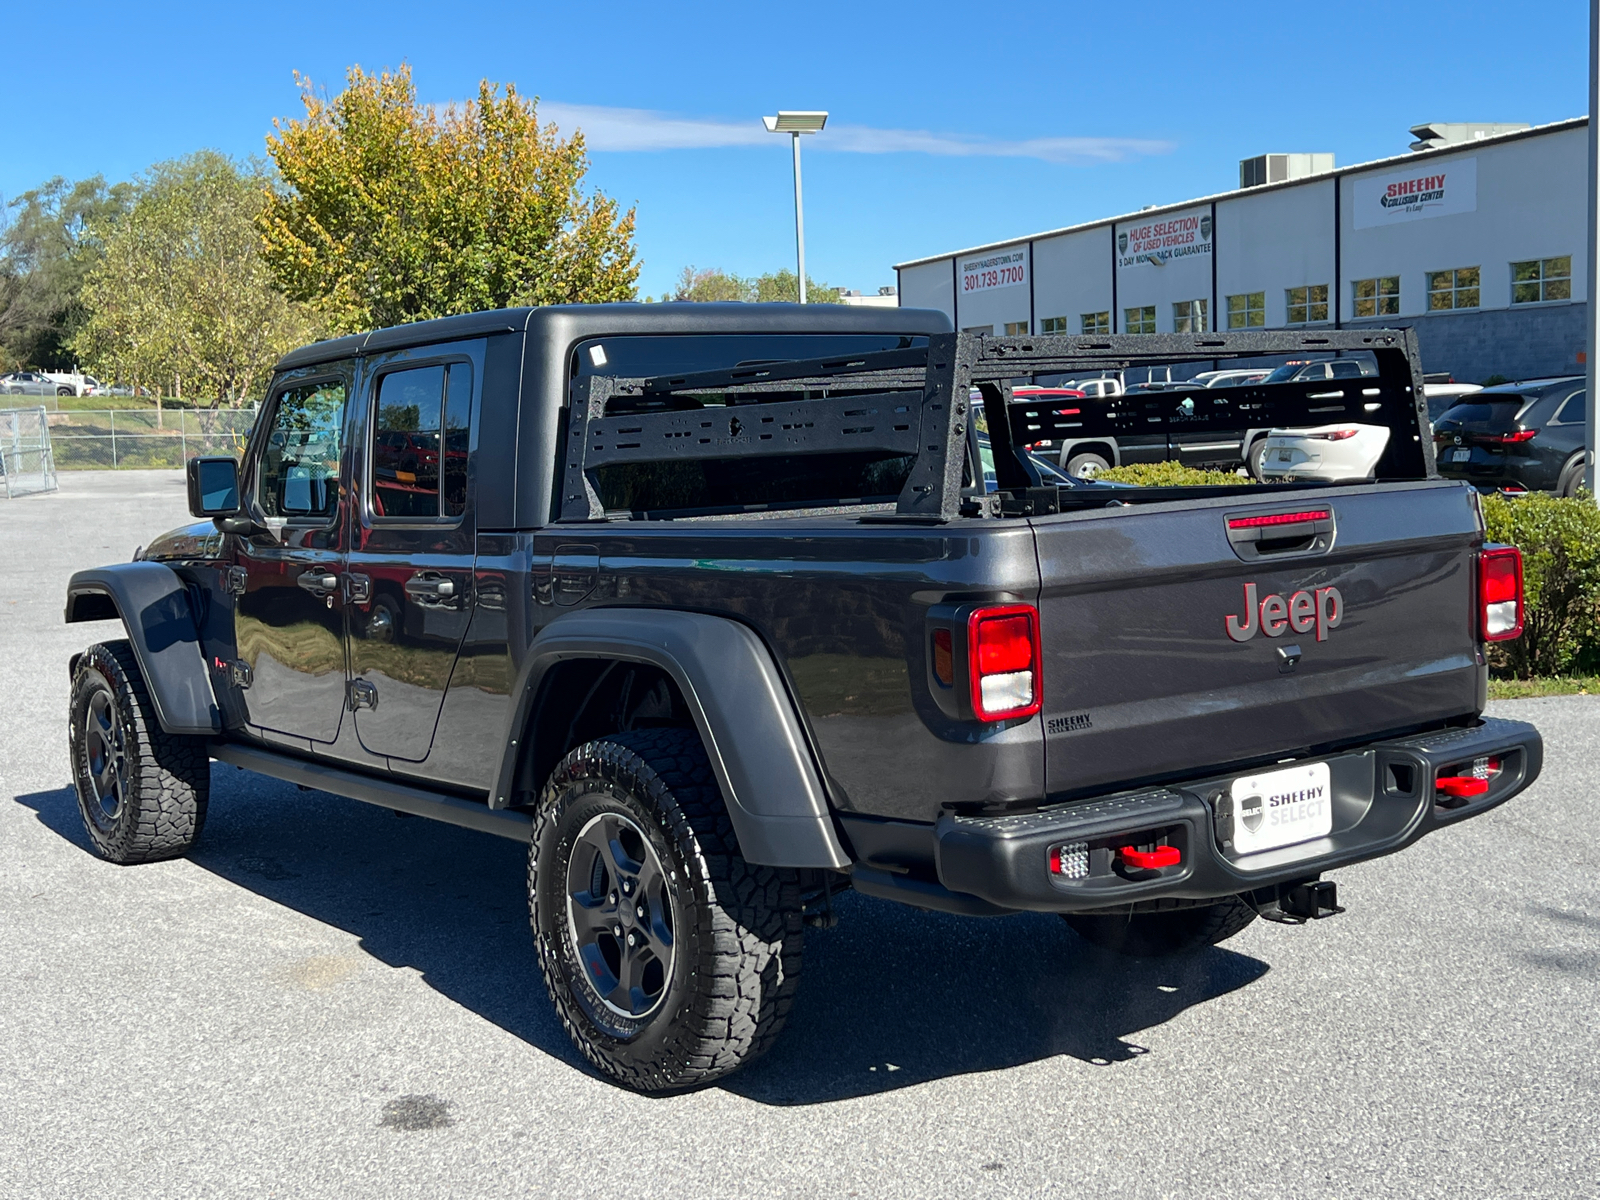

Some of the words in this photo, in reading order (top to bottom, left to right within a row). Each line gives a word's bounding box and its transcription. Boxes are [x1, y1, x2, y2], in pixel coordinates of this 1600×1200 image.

[1387, 174, 1446, 197] SHEEHY
[1387, 193, 1419, 208] COLLISION
[1420, 189, 1445, 203] CENTER
[1129, 226, 1152, 242] HUGE
[1153, 216, 1199, 237] SELECTION
[1133, 241, 1142, 253] OF
[1143, 237, 1161, 251] USED
[1162, 232, 1195, 247] VEHICLES
[1118, 258, 1123, 267] 5
[1123, 256, 1134, 266] DAY
[1174, 243, 1211, 258] GUARANTEE
[964, 265, 1024, 291] 301.739.7700
[1225, 582, 1343, 642] Jeep
[1047, 713, 1090, 728] SHEEHY
[1269, 785, 1324, 807] SHEEHY
[1241, 806, 1263, 818] SELECT
[1270, 799, 1325, 826] SELECT
